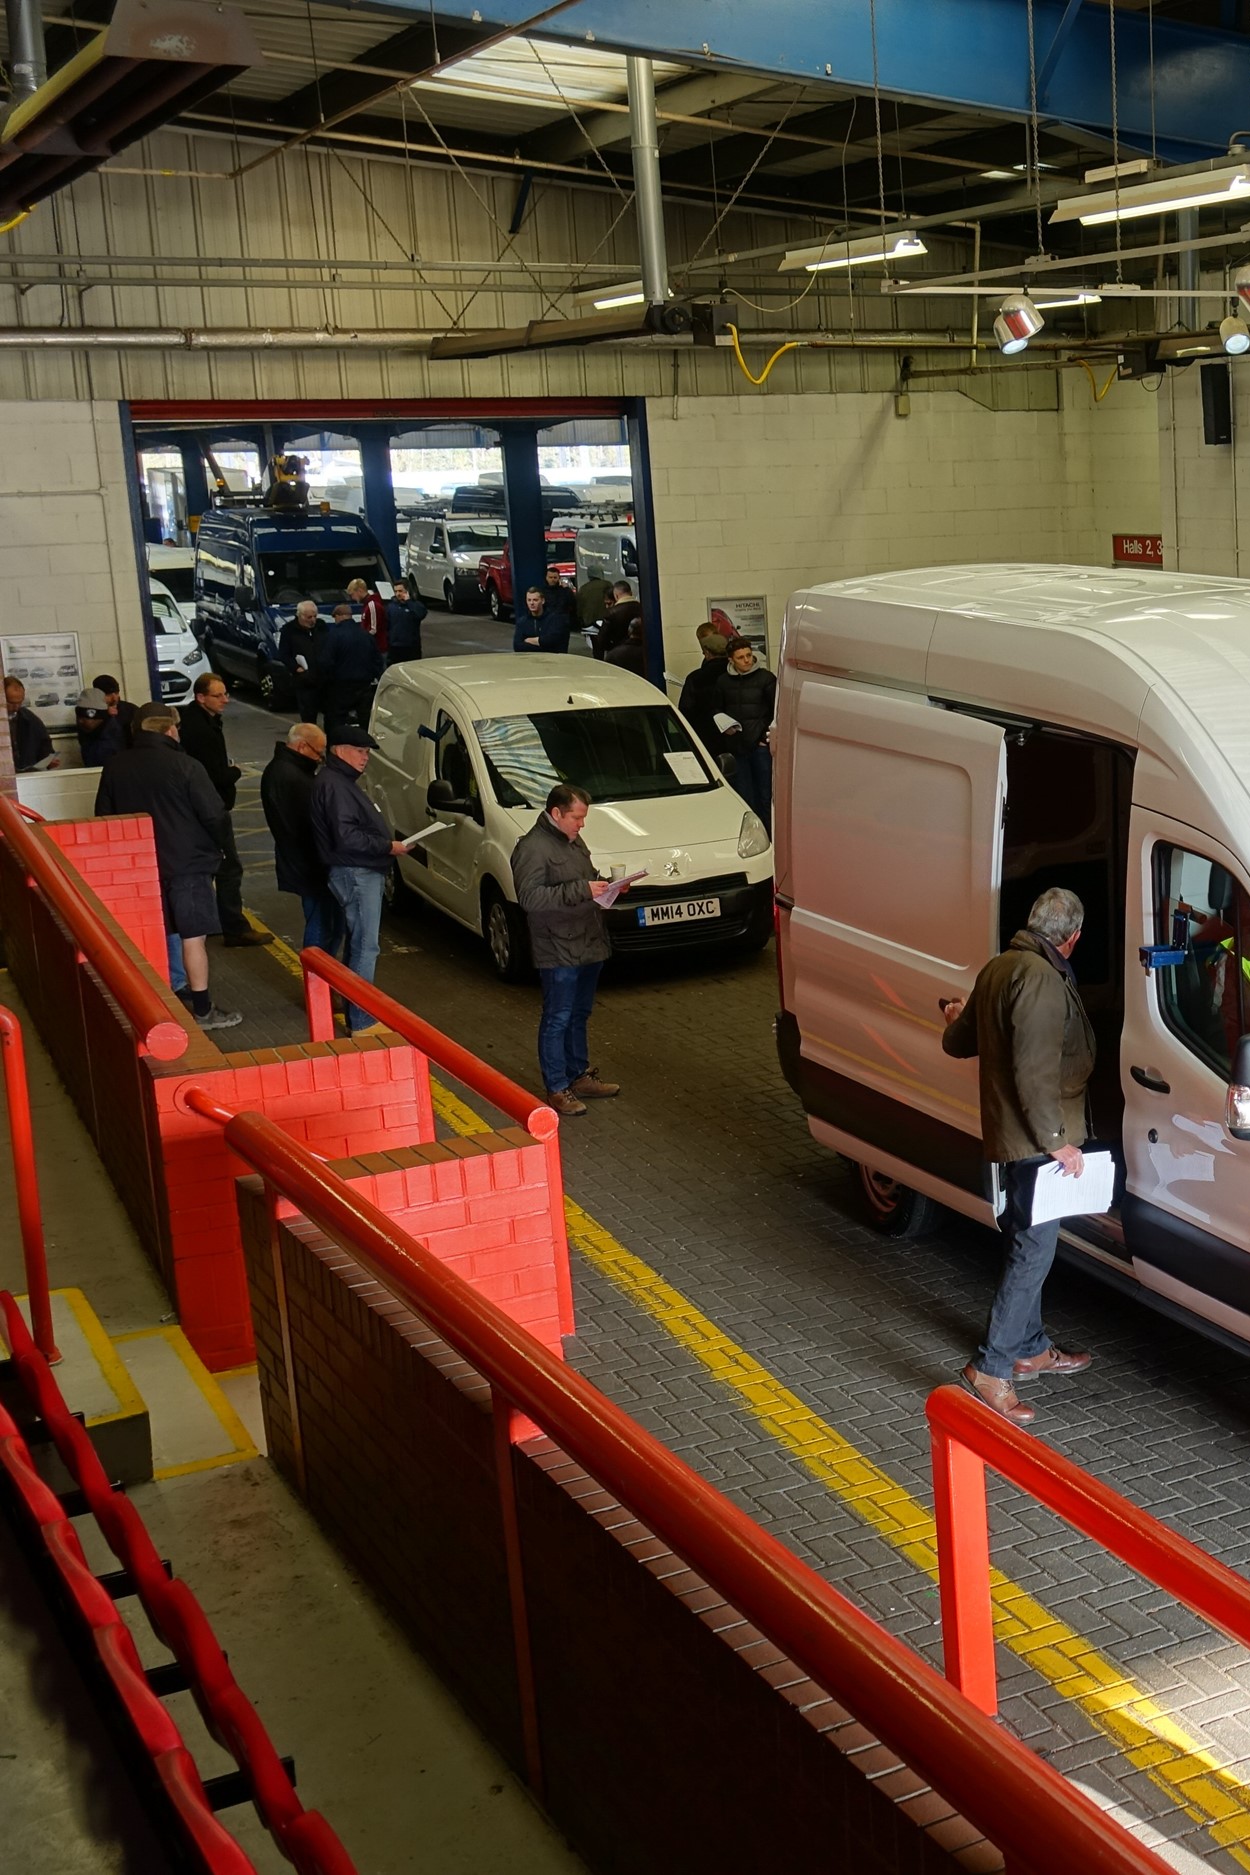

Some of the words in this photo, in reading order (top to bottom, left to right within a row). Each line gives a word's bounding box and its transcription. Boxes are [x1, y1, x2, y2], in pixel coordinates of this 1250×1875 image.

[1123, 539, 1142, 554] Halls
[1145, 540, 1154, 557] 2,
[650, 904, 683, 921] MM14
[687, 901, 715, 916] OXC
